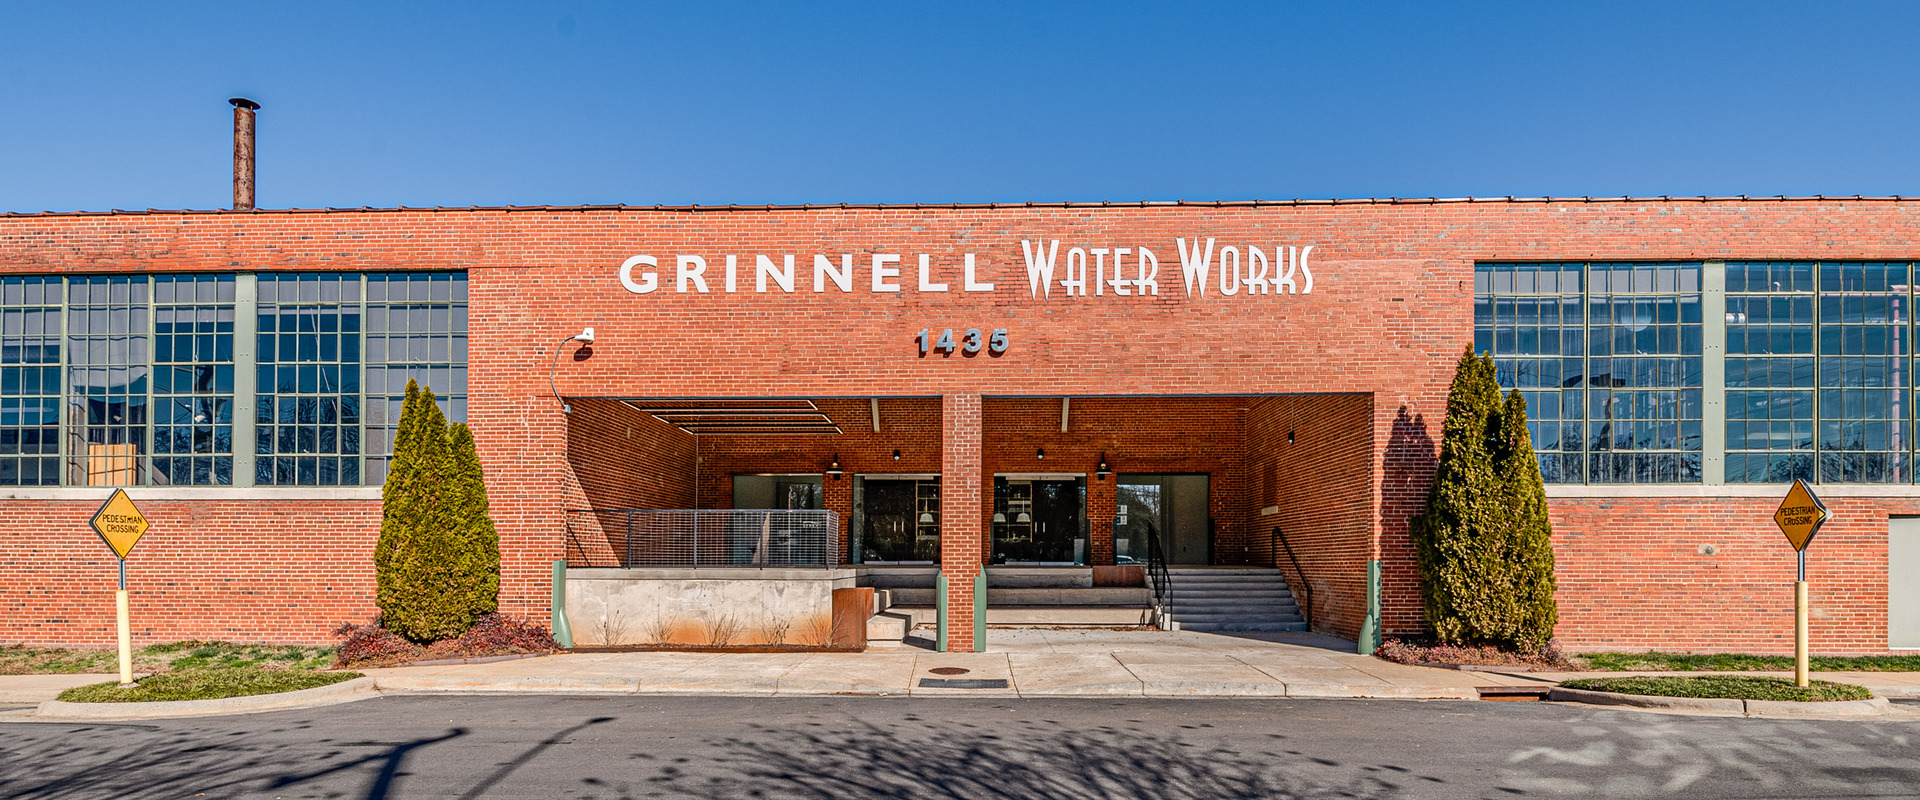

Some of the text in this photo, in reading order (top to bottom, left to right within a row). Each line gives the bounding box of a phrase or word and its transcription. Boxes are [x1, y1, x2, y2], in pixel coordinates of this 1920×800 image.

[619, 235, 1315, 300] GRINNELL WATER WORKS
[917, 328, 1010, 354] 1435
[1781, 506, 1816, 516] PEDESTRIAN
[102, 514, 143, 524] PEDESTRIAN
[1783, 516, 1813, 526] CROSSING
[106, 524, 139, 534] CROSSING
